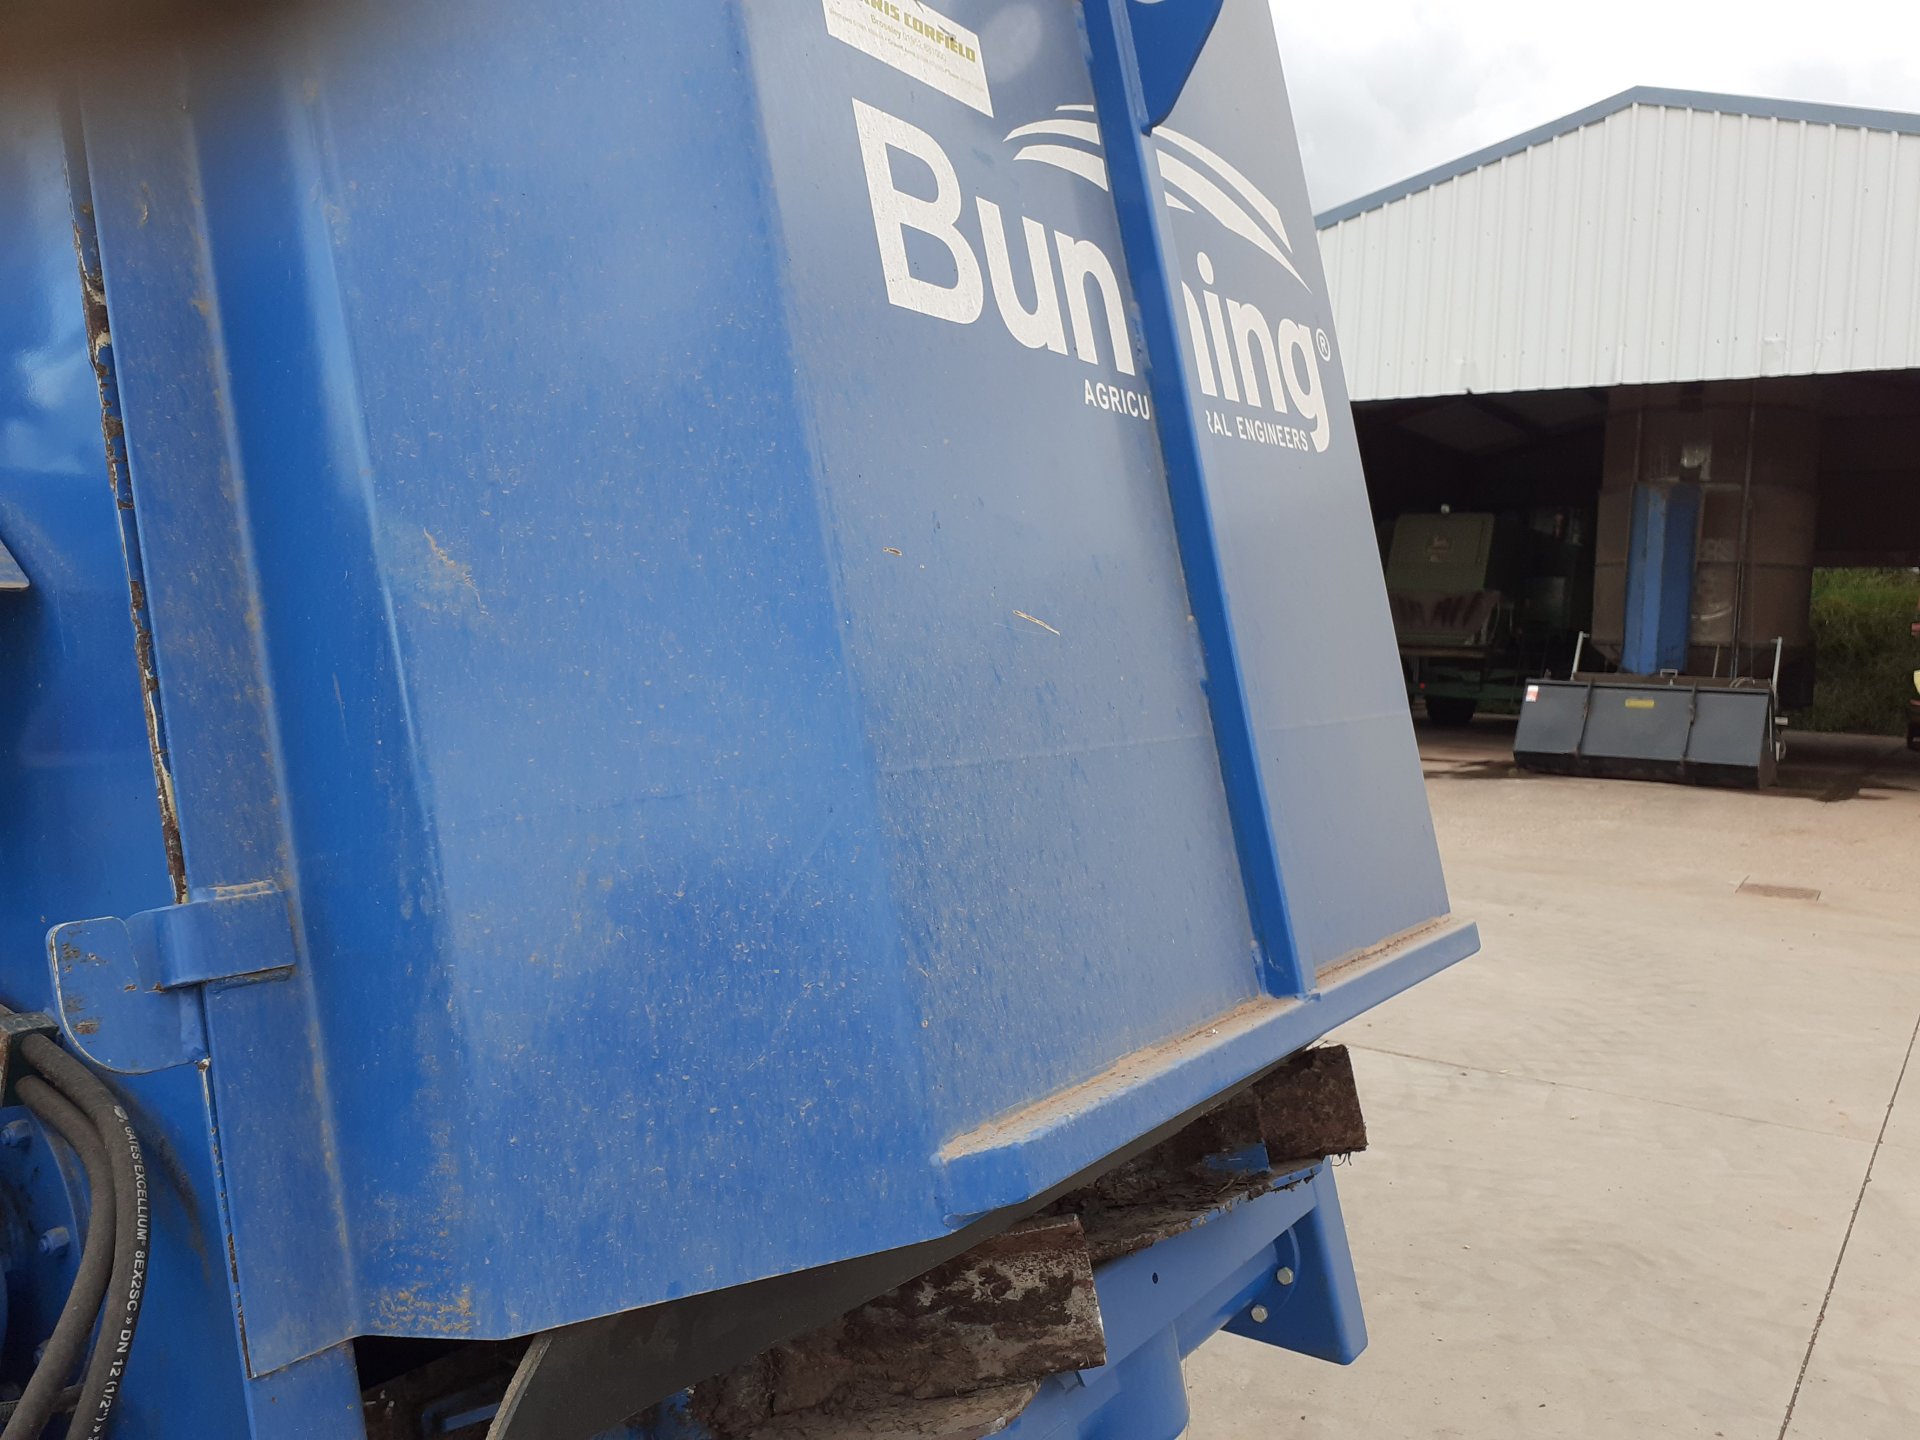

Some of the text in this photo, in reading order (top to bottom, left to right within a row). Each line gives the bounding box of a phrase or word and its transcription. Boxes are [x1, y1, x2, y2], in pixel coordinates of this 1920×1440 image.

[903, 12, 976, 63] CORFIELD
[1236, 416, 1309, 452] ENGINEERS
[133, 1164, 148, 1241] EXCELLIUM
[126, 1250, 146, 1311] 8EX2SC
[116, 1329, 132, 1353] DN
[109, 1358, 123, 1377] 12
